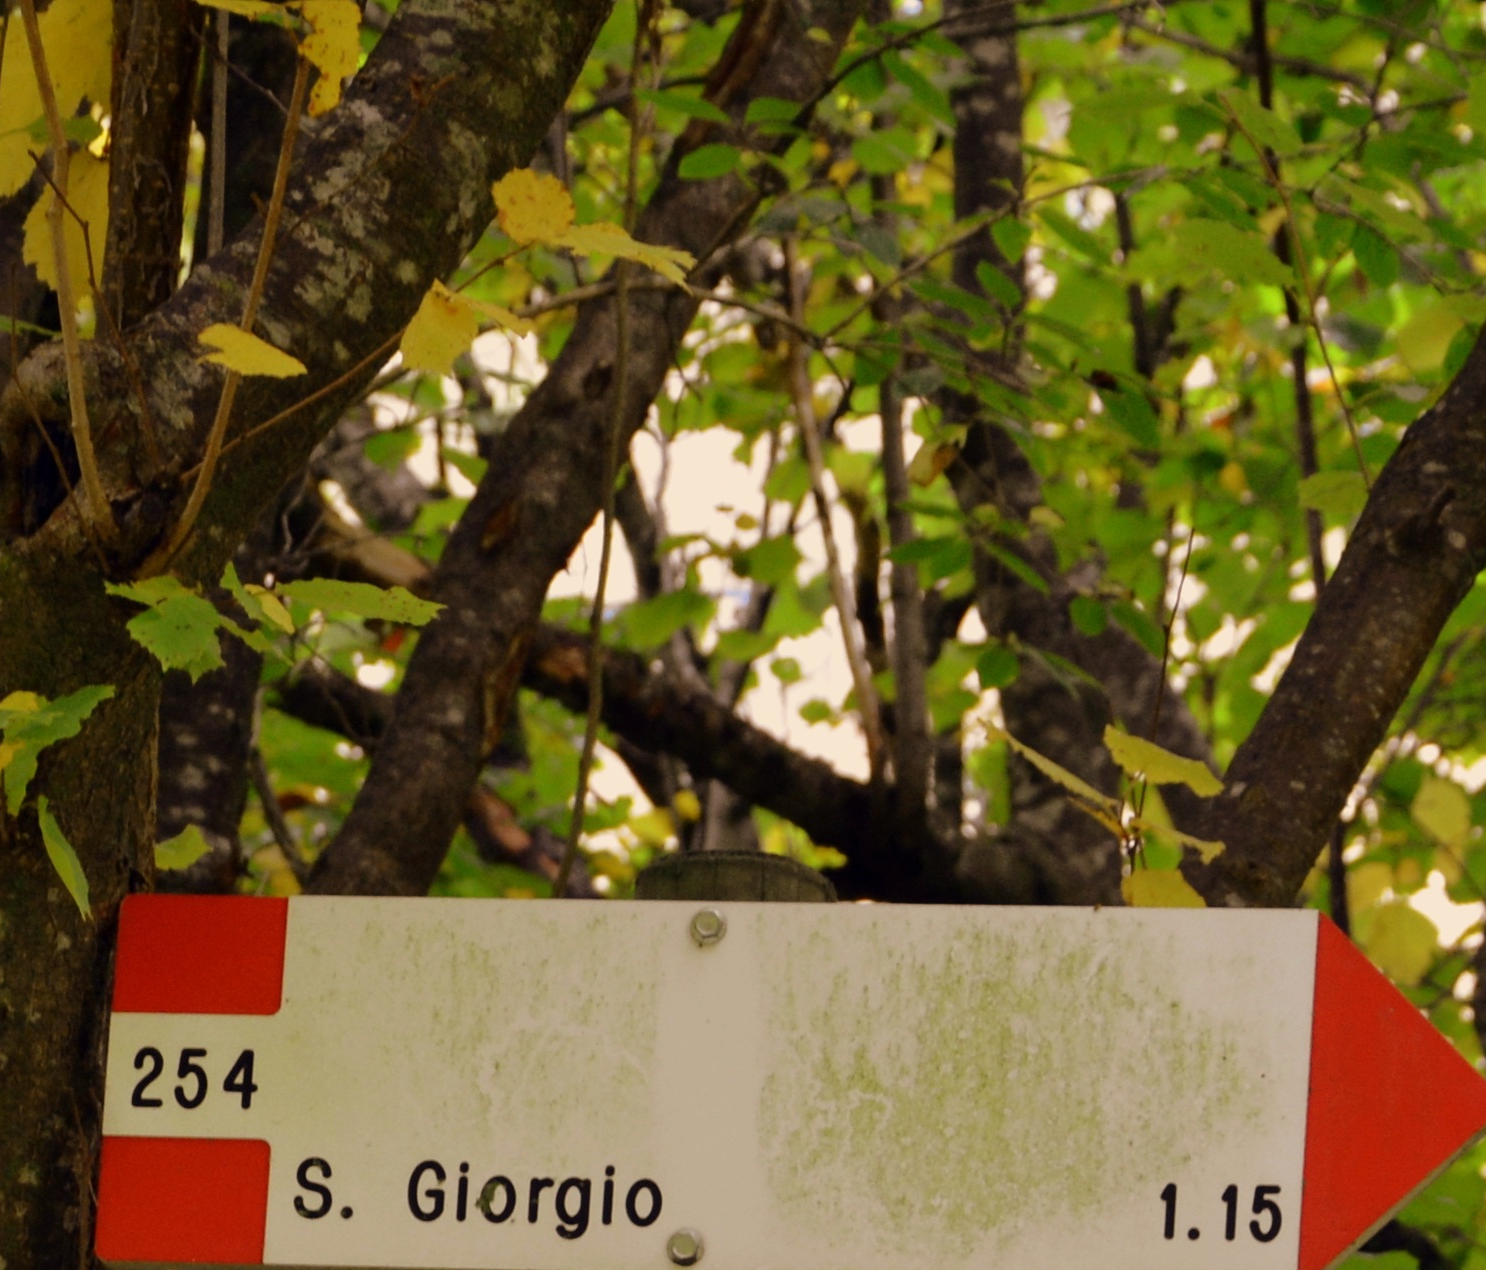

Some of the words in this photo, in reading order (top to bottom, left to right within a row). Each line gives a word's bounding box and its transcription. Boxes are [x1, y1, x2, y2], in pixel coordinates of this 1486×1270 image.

[131, 1046, 258, 1110] 254
[294, 1158, 354, 1221] S.
[408, 1160, 663, 1240] Giorgio
[1160, 1183, 1282, 1243] 1.15
